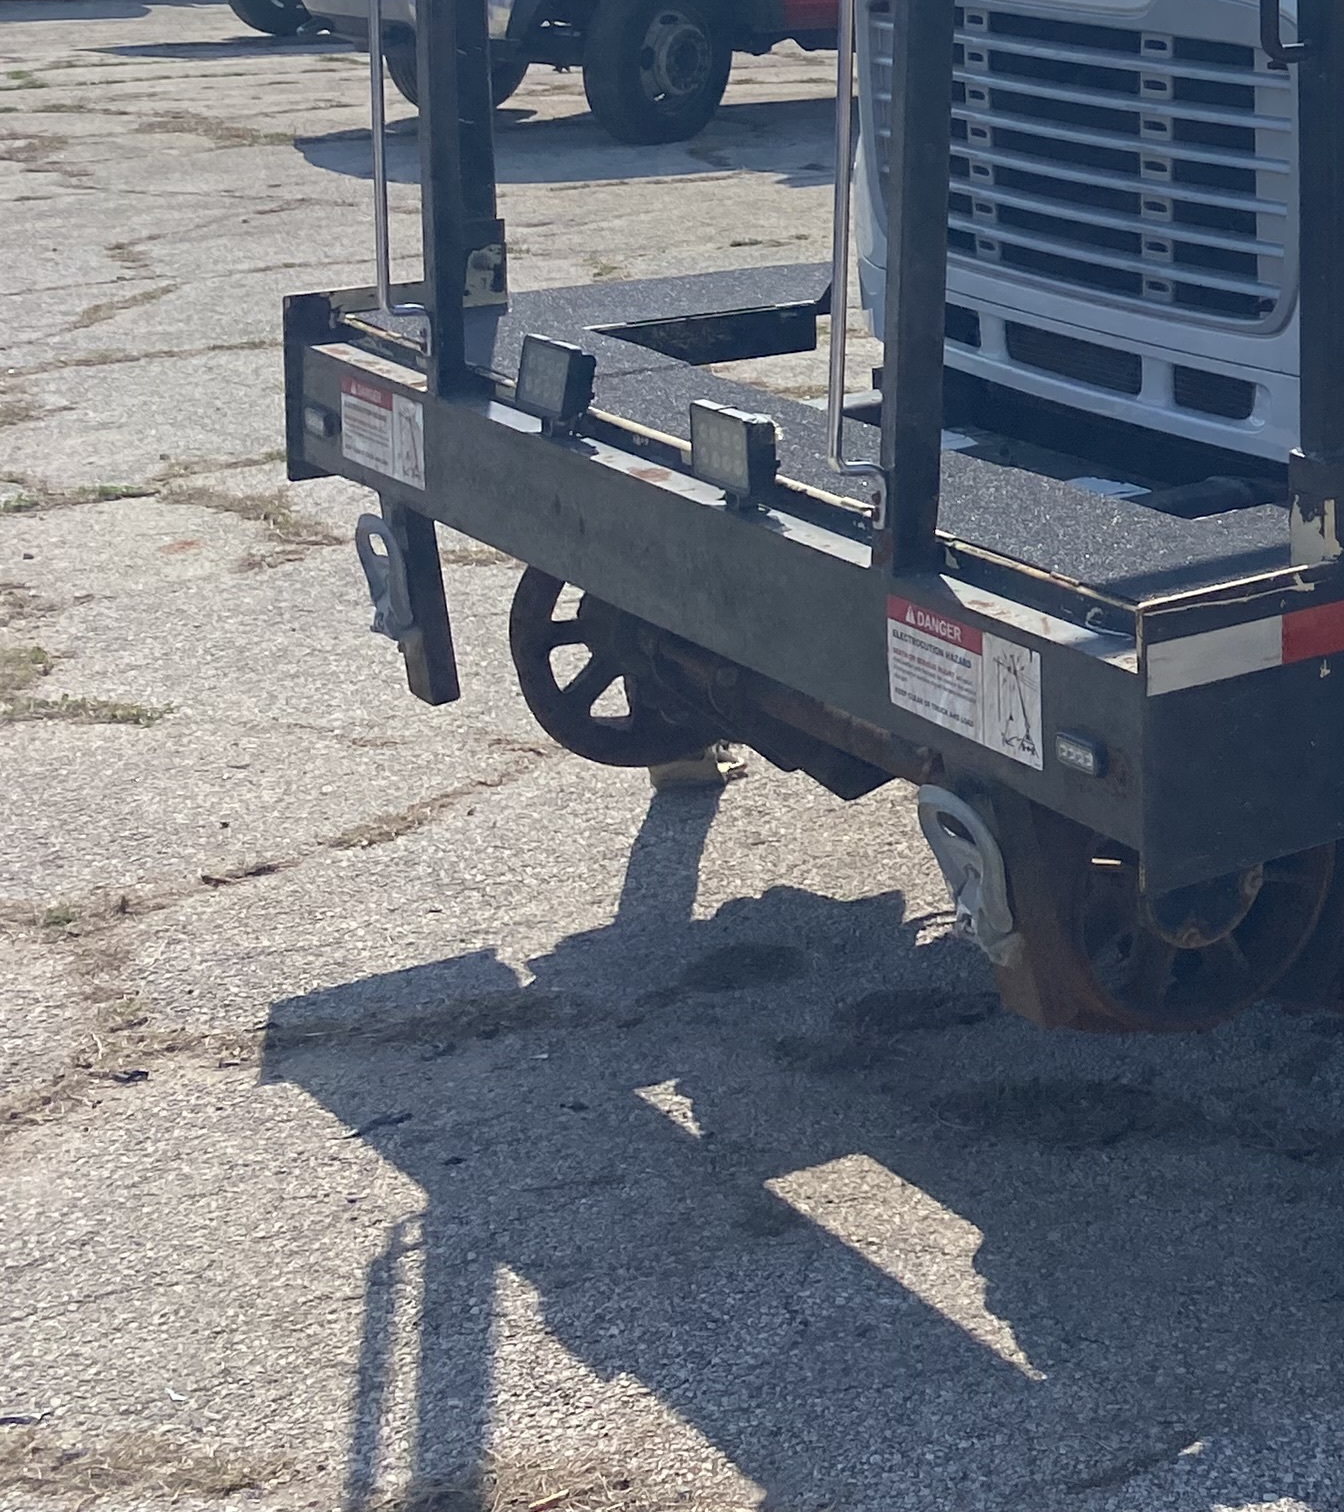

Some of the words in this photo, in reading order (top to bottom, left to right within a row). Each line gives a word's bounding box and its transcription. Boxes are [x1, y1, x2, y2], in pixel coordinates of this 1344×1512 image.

[916, 609, 962, 644] DANGER
[892, 628, 945, 658] ELECTROCUTION
[945, 650, 972, 669] HAZARD
